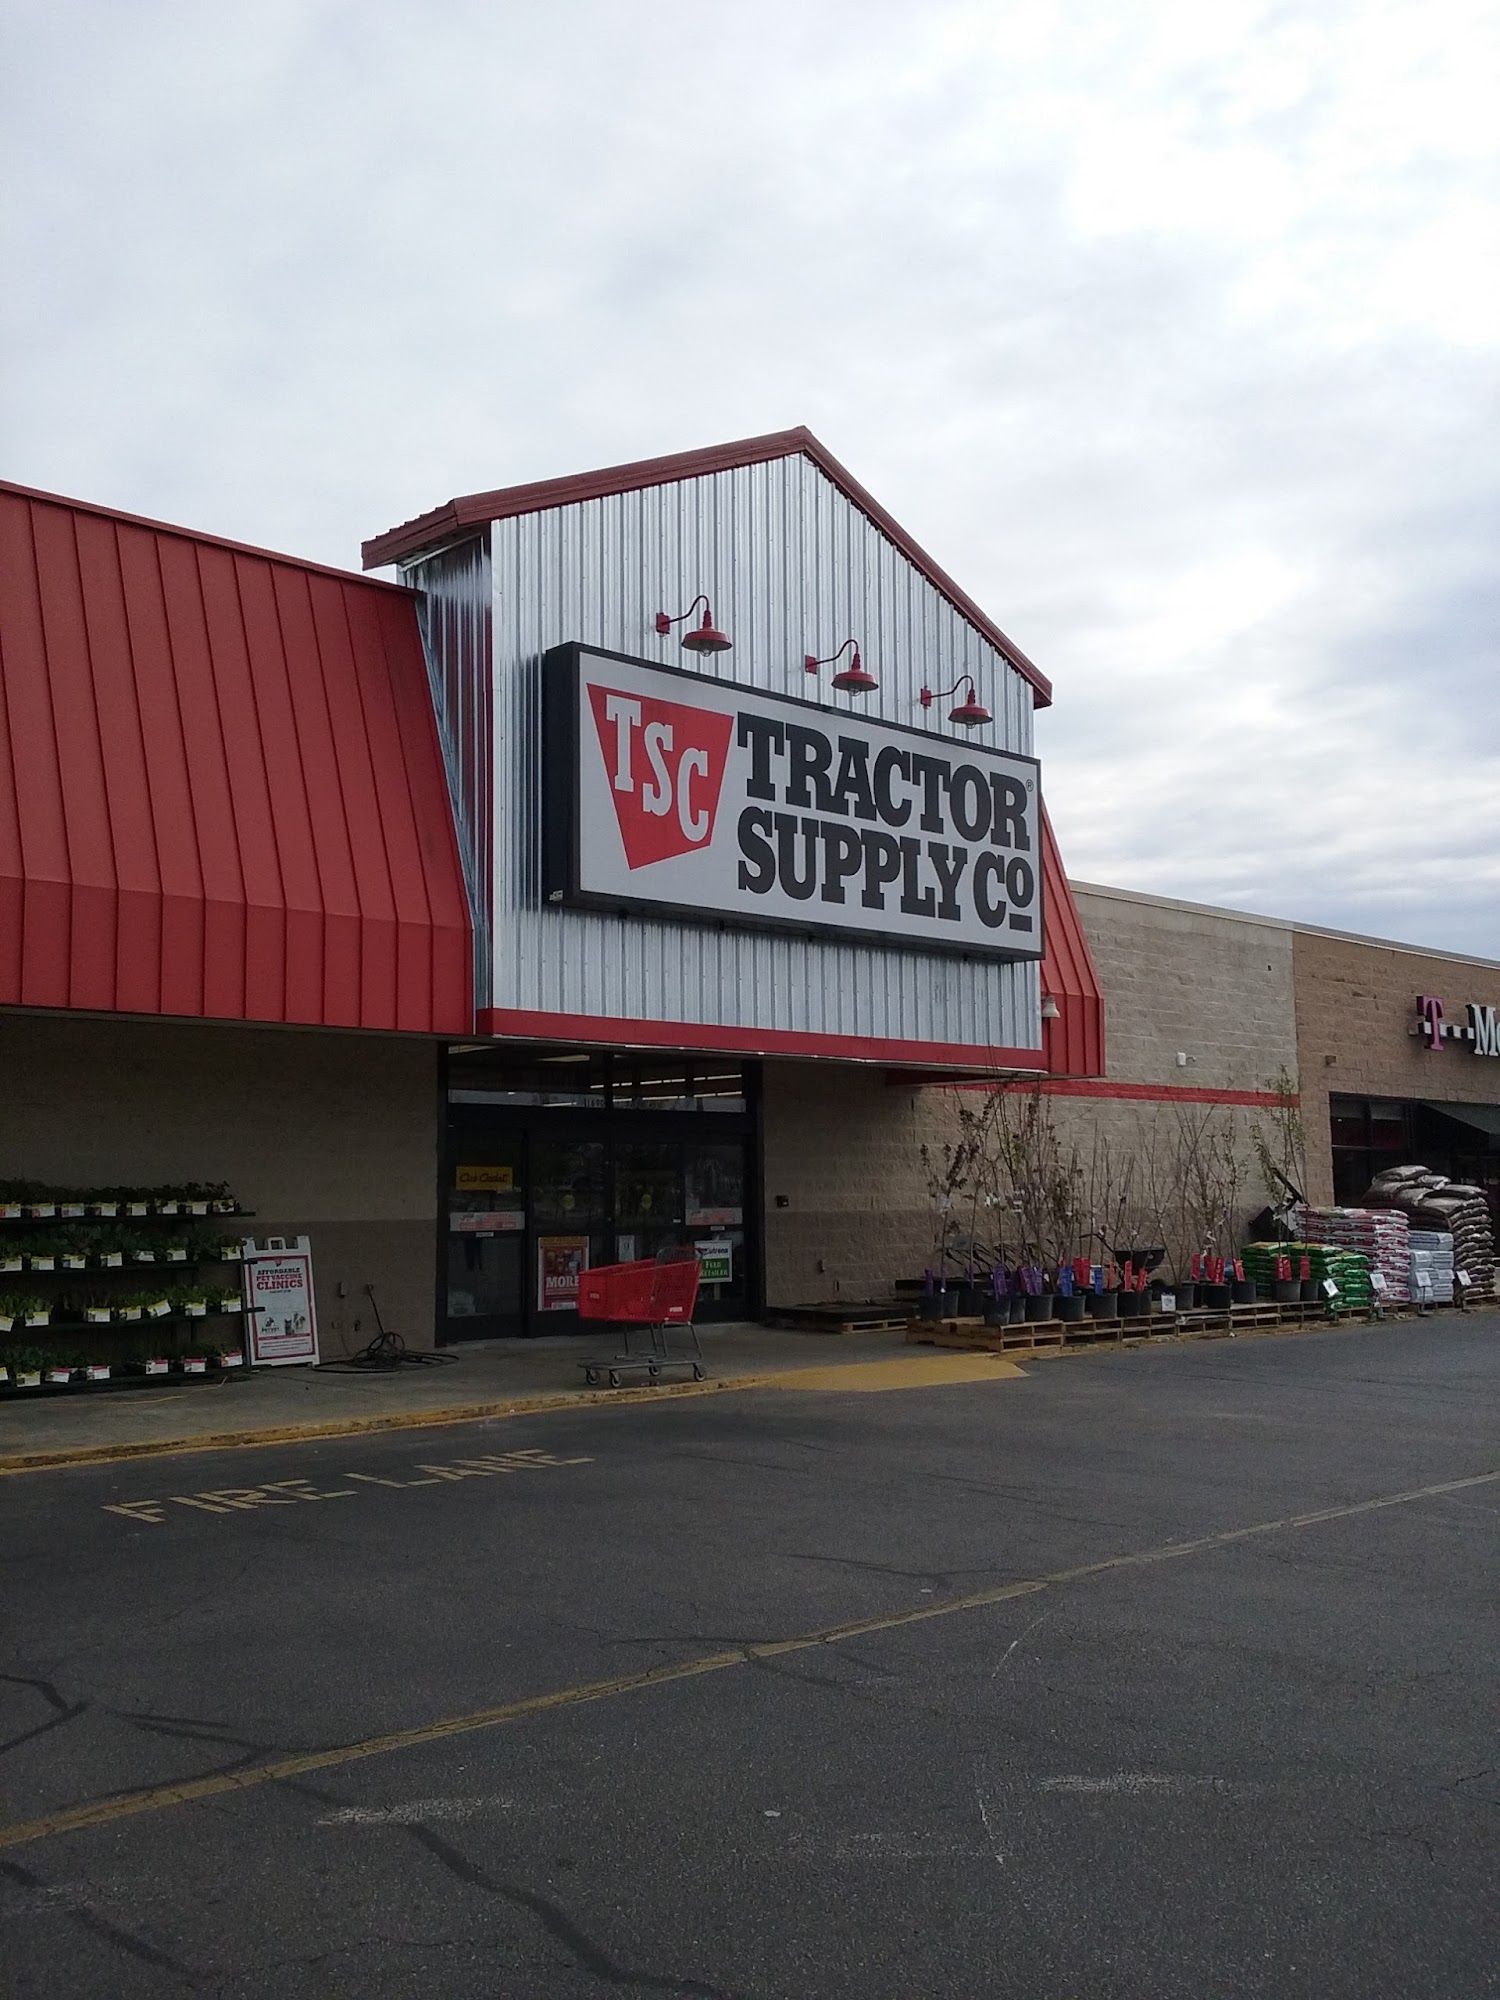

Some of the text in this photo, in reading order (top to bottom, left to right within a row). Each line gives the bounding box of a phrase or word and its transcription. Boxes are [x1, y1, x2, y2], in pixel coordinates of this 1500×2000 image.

[606, 693, 709, 843] TSC
[737, 711, 1031, 852] TRACTOR
[737, 805, 968, 923] SUPPLY
[256, 1279, 303, 1291] CLINICS
[257, 1267, 300, 1275] AFFORDABLE
[271, 1272, 302, 1280] VACCINE
[545, 1275, 580, 1288] MORE
[102, 1448, 596, 1523] FIRE LANE
